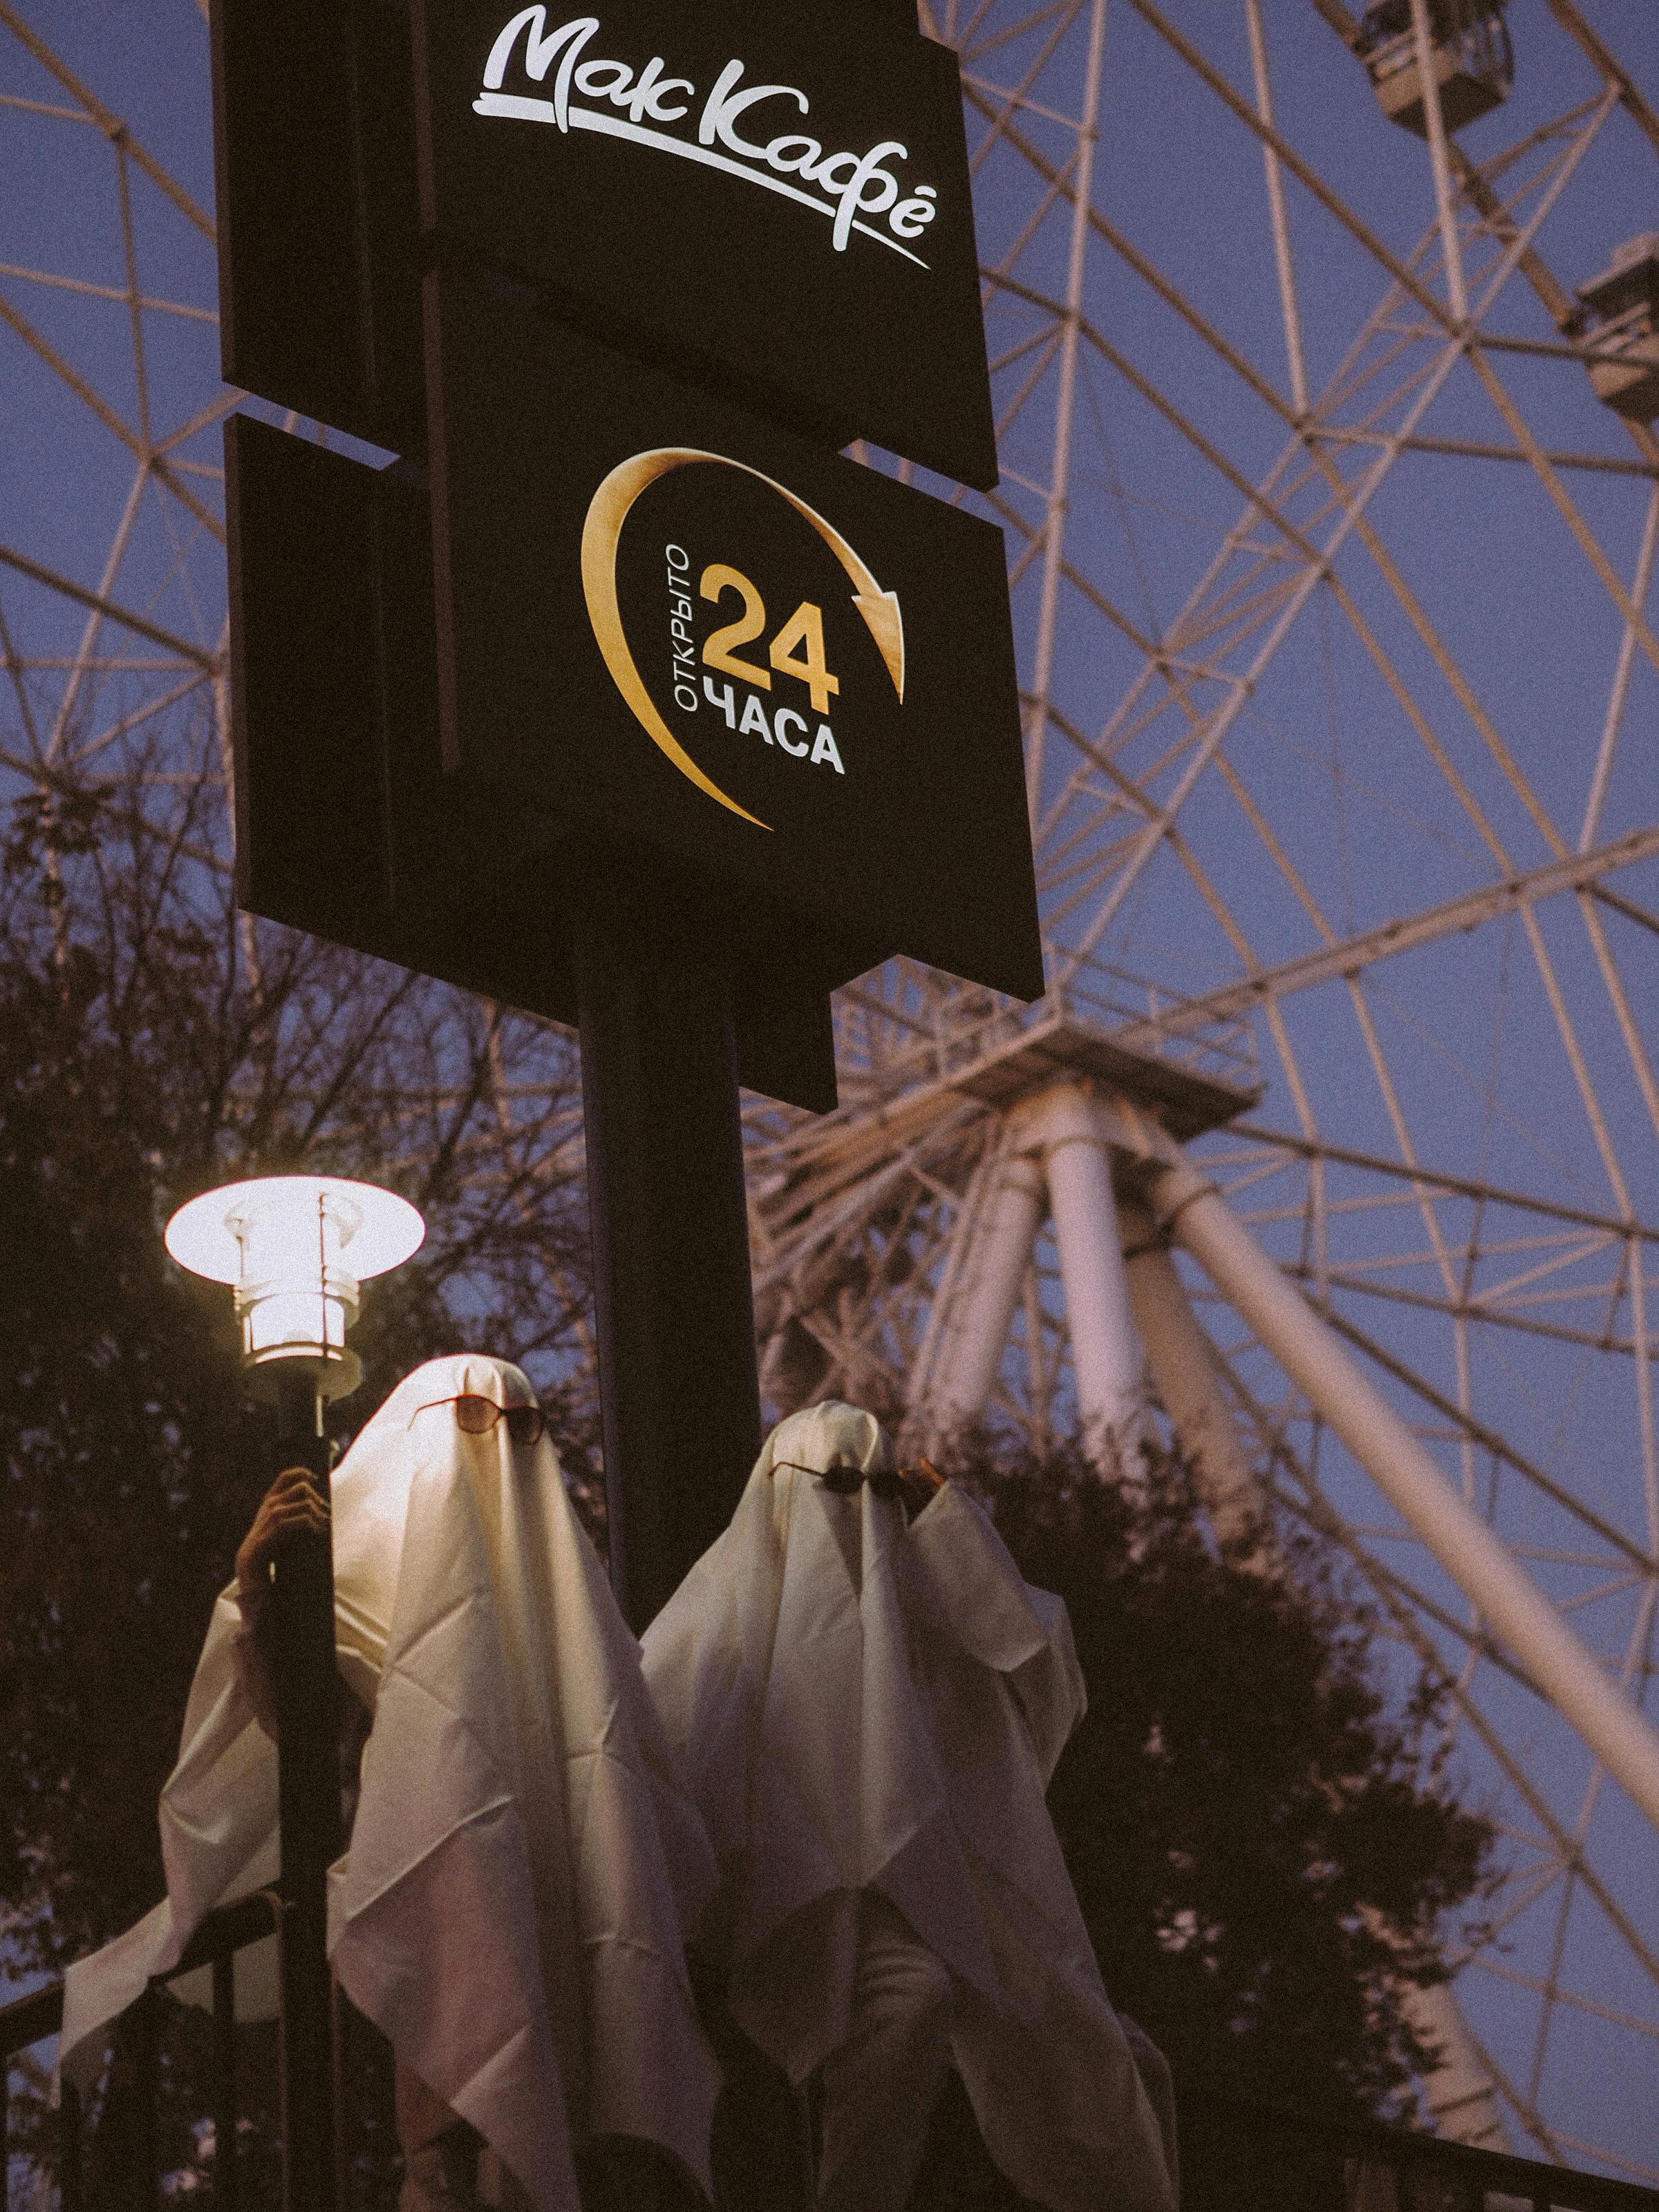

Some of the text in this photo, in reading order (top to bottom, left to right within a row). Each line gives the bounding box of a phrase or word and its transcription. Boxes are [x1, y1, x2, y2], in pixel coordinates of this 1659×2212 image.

[665, 543, 698, 712] ОТКРЫТО
[700, 563, 840, 715] 24
[702, 675, 845, 775] ЧАСА
